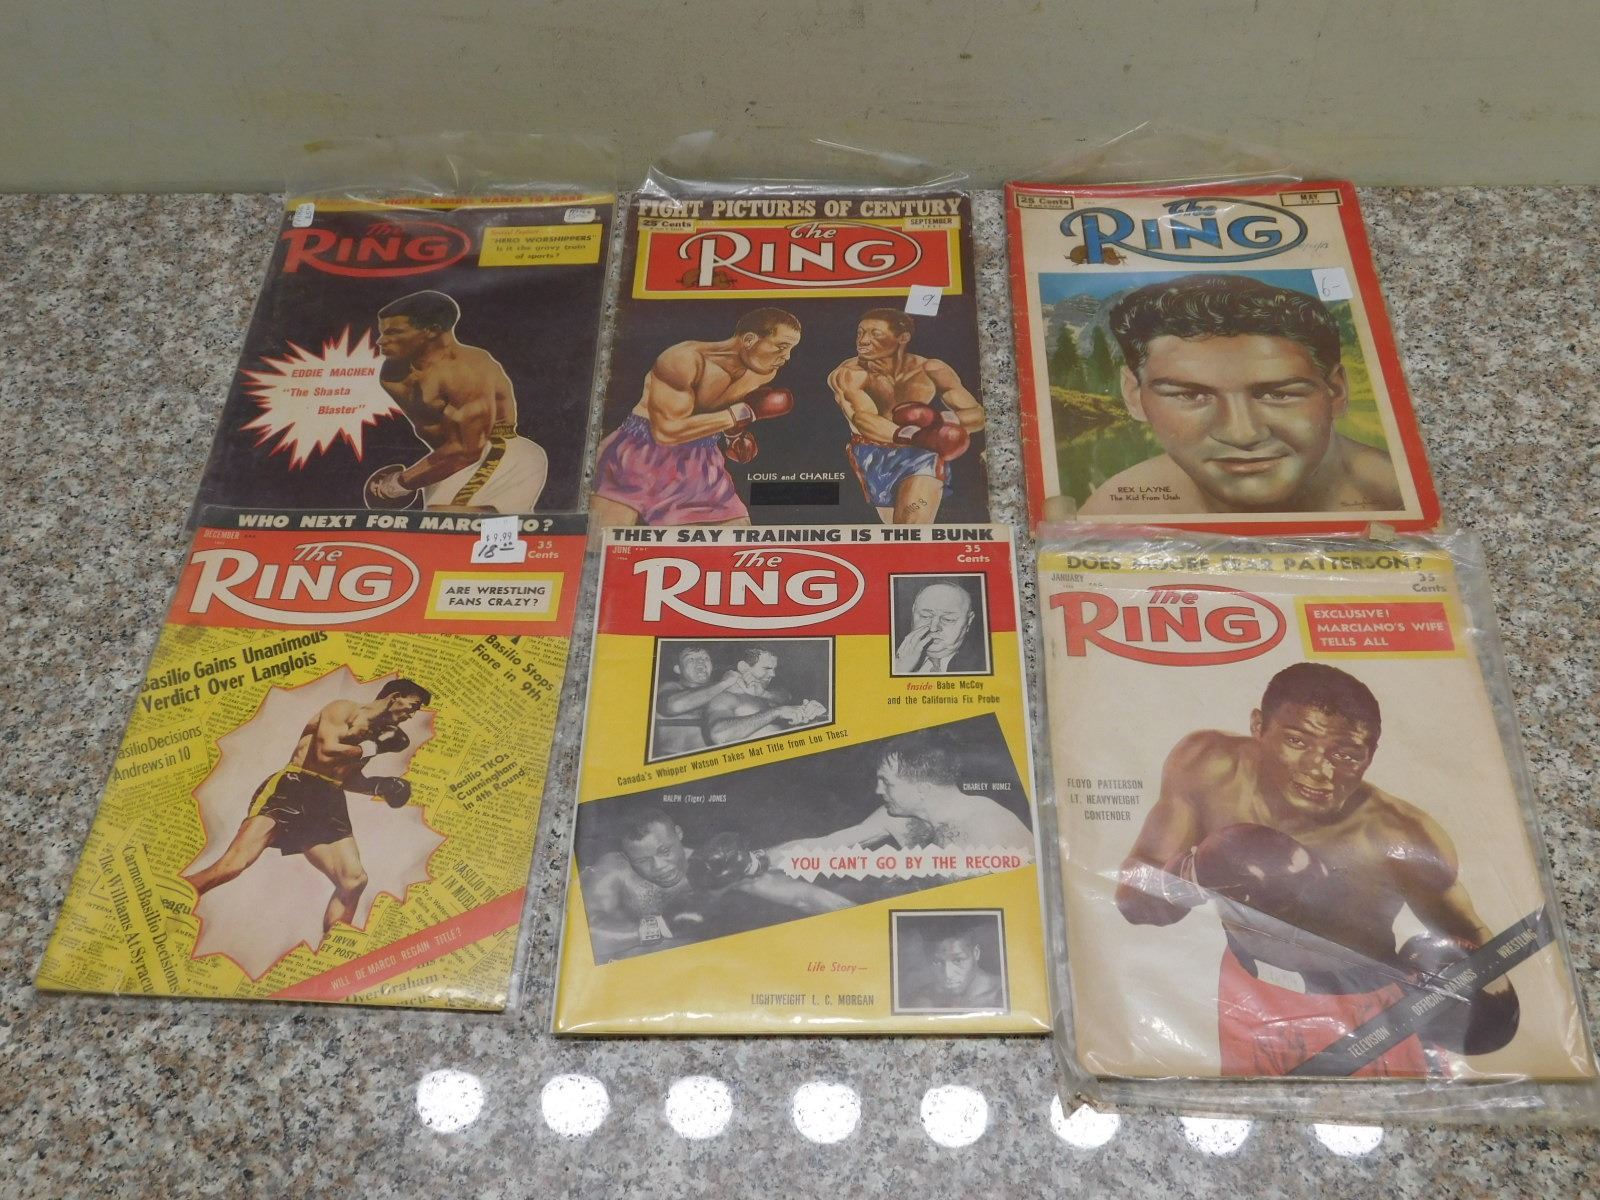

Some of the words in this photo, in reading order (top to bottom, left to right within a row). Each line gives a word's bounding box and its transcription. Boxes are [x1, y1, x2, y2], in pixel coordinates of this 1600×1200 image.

[638, 199, 704, 218] FIGHT
[712, 199, 816, 217] PICTURES
[824, 199, 853, 217] OF
[860, 198, 961, 217] CENTURY
[1039, 197, 1069, 205] Cents
[1164, 199, 1217, 217] The
[661, 220, 692, 228] Cents
[787, 221, 838, 239] The
[1060, 207, 1291, 265] RING
[281, 227, 465, 276] RING
[679, 230, 905, 287] RING
[291, 369, 324, 378] EDDIE
[330, 368, 375, 377] MACHEN
[283, 388, 309, 397] "The
[313, 387, 351, 396] Shasta
[318, 405, 365, 415] Blaster"
[747, 473, 778, 481] LOUIS
[781, 473, 796, 481] and
[799, 472, 846, 481] CHARLES
[238, 515, 290, 528] WHO
[299, 515, 357, 528] NEXT
[366, 515, 408, 530] FOR
[203, 531, 240, 540] DECEMBER
[612, 529, 668, 542] THEY
[676, 529, 727, 542] SAY
[733, 529, 841, 542] TRAINING
[851, 529, 872, 541] IS
[881, 528, 921, 541] THE
[931, 528, 994, 541] BUNK
[537, 541, 553, 549] 35
[612, 546, 631, 554] JUNE
[965, 545, 981, 553] 35
[293, 543, 344, 562] The
[528, 550, 559, 559] Cents
[733, 550, 783, 568] The
[957, 554, 991, 563] Cents
[1067, 555, 1121, 570] DOES
[1283, 556, 1422, 571] PATTERSON?
[1051, 574, 1084, 582] JANUARY
[1418, 573, 1436, 582] 35
[187, 548, 410, 623] RING
[445, 586, 470, 595] ARE
[478, 586, 546, 595] WRESTLING
[1412, 583, 1447, 593] Cents
[633, 557, 851, 629] RING
[1149, 590, 1200, 605] The
[449, 598, 482, 606] FANS
[488, 598, 539, 606] CRAZY?
[1313, 609, 1390, 619] EXCLUSIVE!
[1050, 591, 1272, 665] RING
[1317, 622, 1406, 633] MARCIANO'S
[1412, 622, 1445, 632] WIFE
[1320, 637, 1357, 647] TELLS
[1363, 637, 1389, 647] ALL
[193, 656, 237, 679] Gains
[242, 630, 328, 664] Unanimous
[485, 634, 522, 665] Basilio
[522, 662, 554, 691] Stops
[472, 643, 501, 670] Fiore
[503, 668, 516, 682] in
[520, 681, 541, 702] 9th
[141, 684, 200, 713] Verdict
[207, 673, 245, 695] Over
[251, 651, 317, 683] Langlois
[906, 681, 933, 691] Inside
[936, 681, 955, 690] Babe
[960, 680, 984, 691] McCoy
[887, 696, 901, 705] and
[905, 696, 918, 705] the
[922, 695, 959, 705] California
[962, 695, 974, 704] Fix
[977, 694, 1000, 704] Probe
[147, 726, 202, 752] Decisions
[112, 757, 163, 781] Andrews
[165, 753, 176, 767] in
[178, 745, 191, 763] 10
[617, 771, 653, 787] Canada's
[656, 763, 688, 779] Whipper
[691, 757, 719, 771] Watson
[723, 751, 745, 764] Takes
[748, 746, 764, 758] Mat
[766, 741, 785, 754] Title
[787, 737, 806, 749] from
[808, 734, 823, 745] Lou
[827, 729, 848, 742] Thesz
[449, 770, 481, 793] Basilio
[457, 761, 518, 801] Cunningham
[963, 783, 988, 791] CHARLEY
[1067, 778, 1092, 789] FLOYD
[1097, 779, 1143, 790] PATTERSON
[462, 802, 474, 811] In
[476, 789, 493, 803] 4th
[492, 768, 525, 792] Round
[663, 794, 682, 803] RALPH
[685, 794, 705, 803] (Tiger)
[708, 794, 727, 803] JONES
[1086, 795, 1141, 805] HEAVYWEIGHT
[1084, 810, 1131, 821] CONTENDER
[791, 857, 820, 870] YOU
[829, 856, 868, 870] CAN'T
[876, 856, 897, 870] GO
[905, 856, 923, 870] BY
[932, 856, 957, 870] THE
[965, 855, 1021, 869] RECORD
[107, 873, 133, 932] Williams
[138, 888, 162, 933] Basilio
[152, 931, 180, 993] Decisions
[330, 975, 351, 990] WILL
[367, 955, 397, 975] MARCO
[401, 941, 431, 961] REGAIN
[433, 927, 462, 946] TITLE?
[807, 961, 825, 973] Life
[751, 994, 806, 1006] LIGHTWEIGHT
[838, 994, 875, 1006] MORGAN
[1347, 1025, 1391, 1058] TELEVISION
[1498, 928, 1538, 959] WRESTLING
